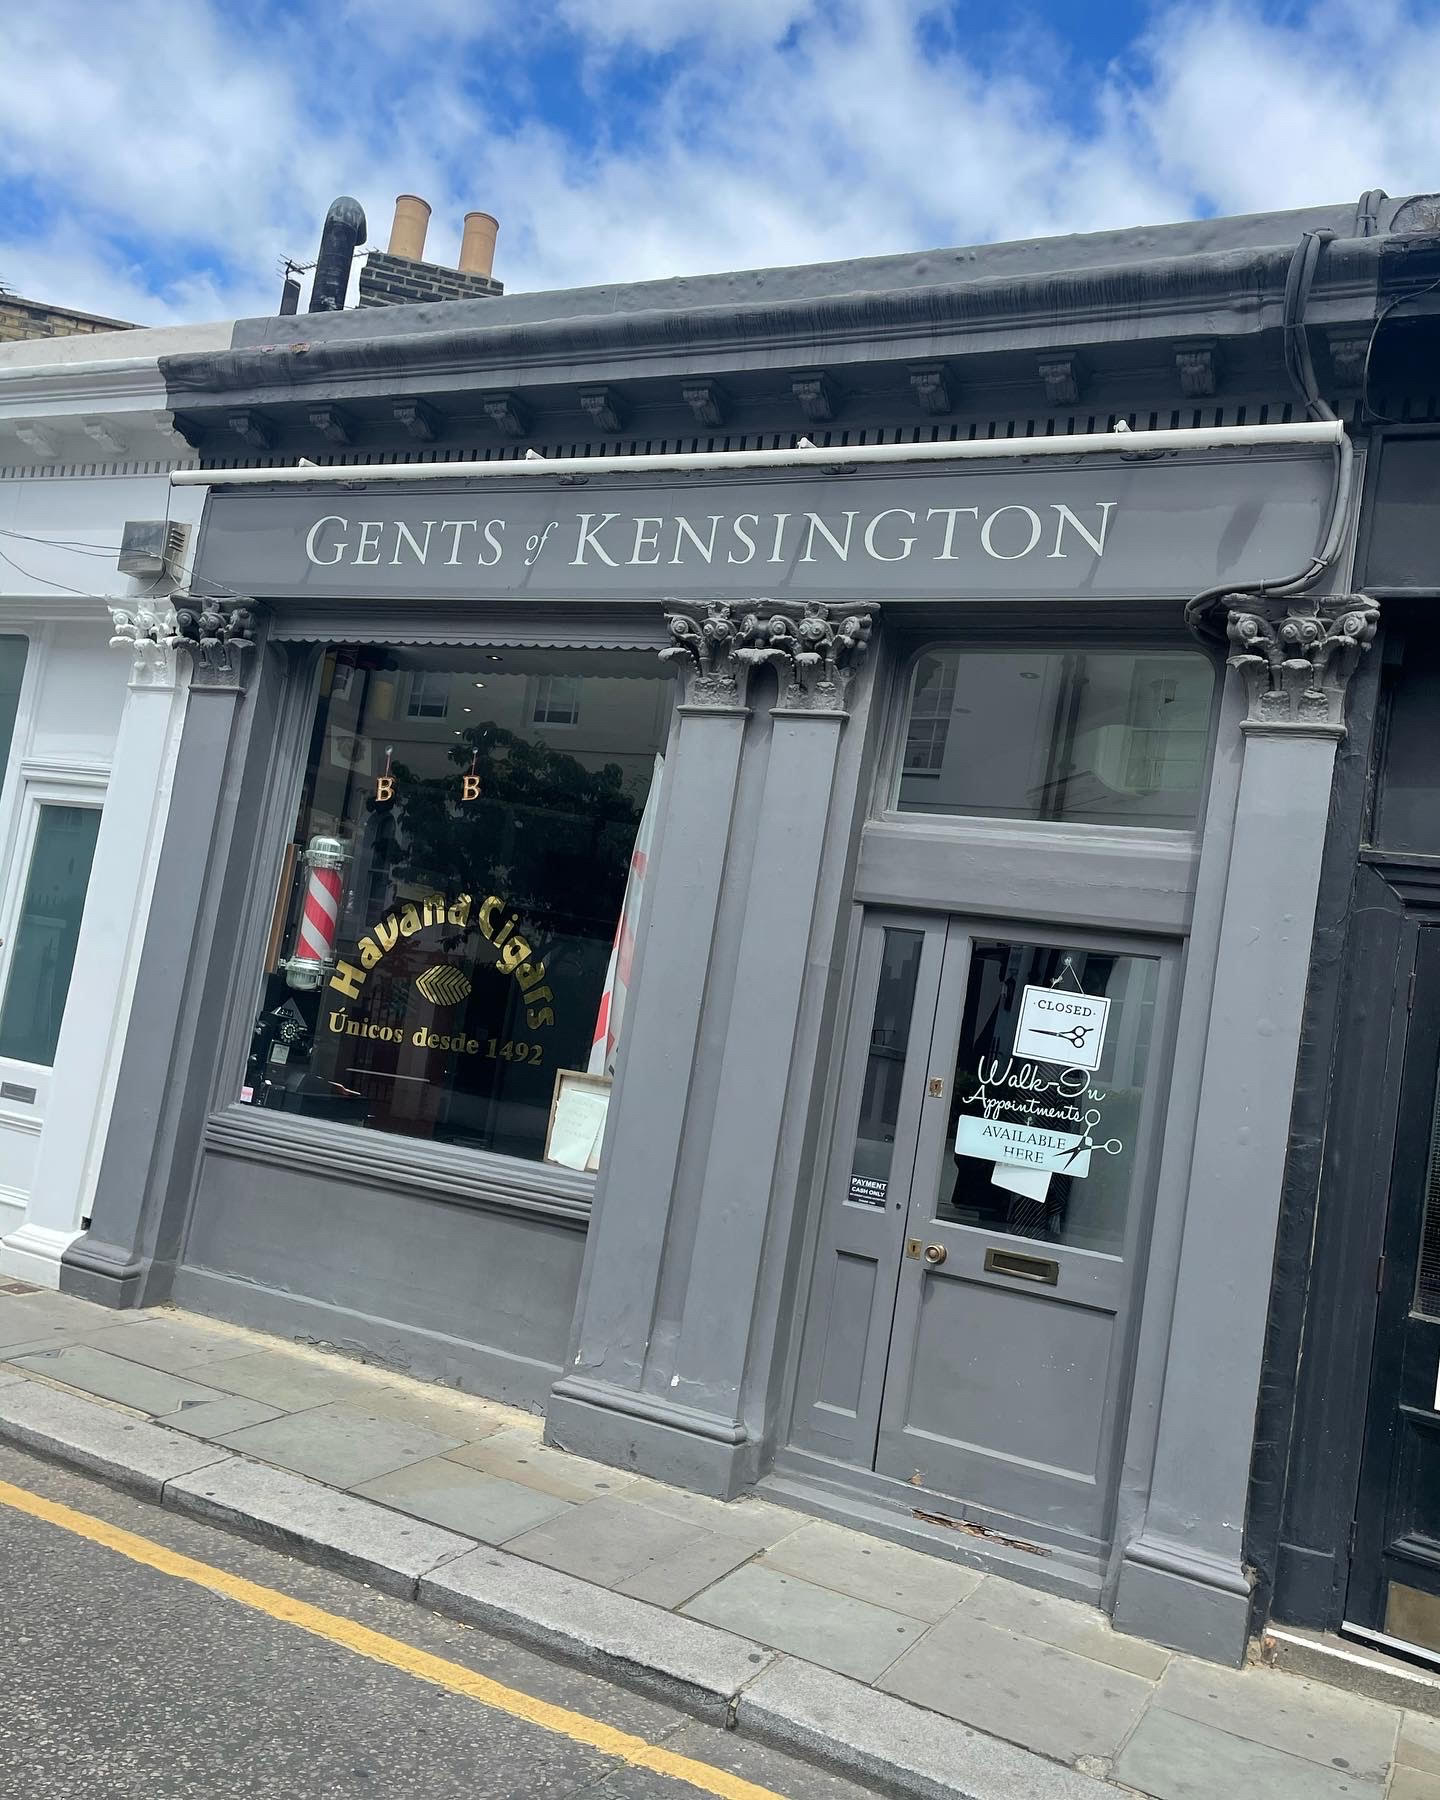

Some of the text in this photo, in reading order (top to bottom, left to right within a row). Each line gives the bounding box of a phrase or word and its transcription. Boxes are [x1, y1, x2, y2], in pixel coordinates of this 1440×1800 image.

[305, 501, 1118, 567] GENTS of KENSINGTON
[375, 775, 481, 802] B B
[329, 893, 554, 1030] Havana Cigars
[1037, 999, 1092, 1017] CLOSED
[328, 1007, 544, 1066] Únicos desde 1492
[977, 1055, 1106, 1101] Walk-In
[962, 1084, 1085, 1122] Appointments
[982, 1125, 1067, 1150] AVAILABLE
[1004, 1145, 1044, 1164] HERE
[851, 1177, 887, 1191] PAYMENT
[851, 1186, 868, 1195] CASH
[869, 1190, 885, 1198] ONLY
